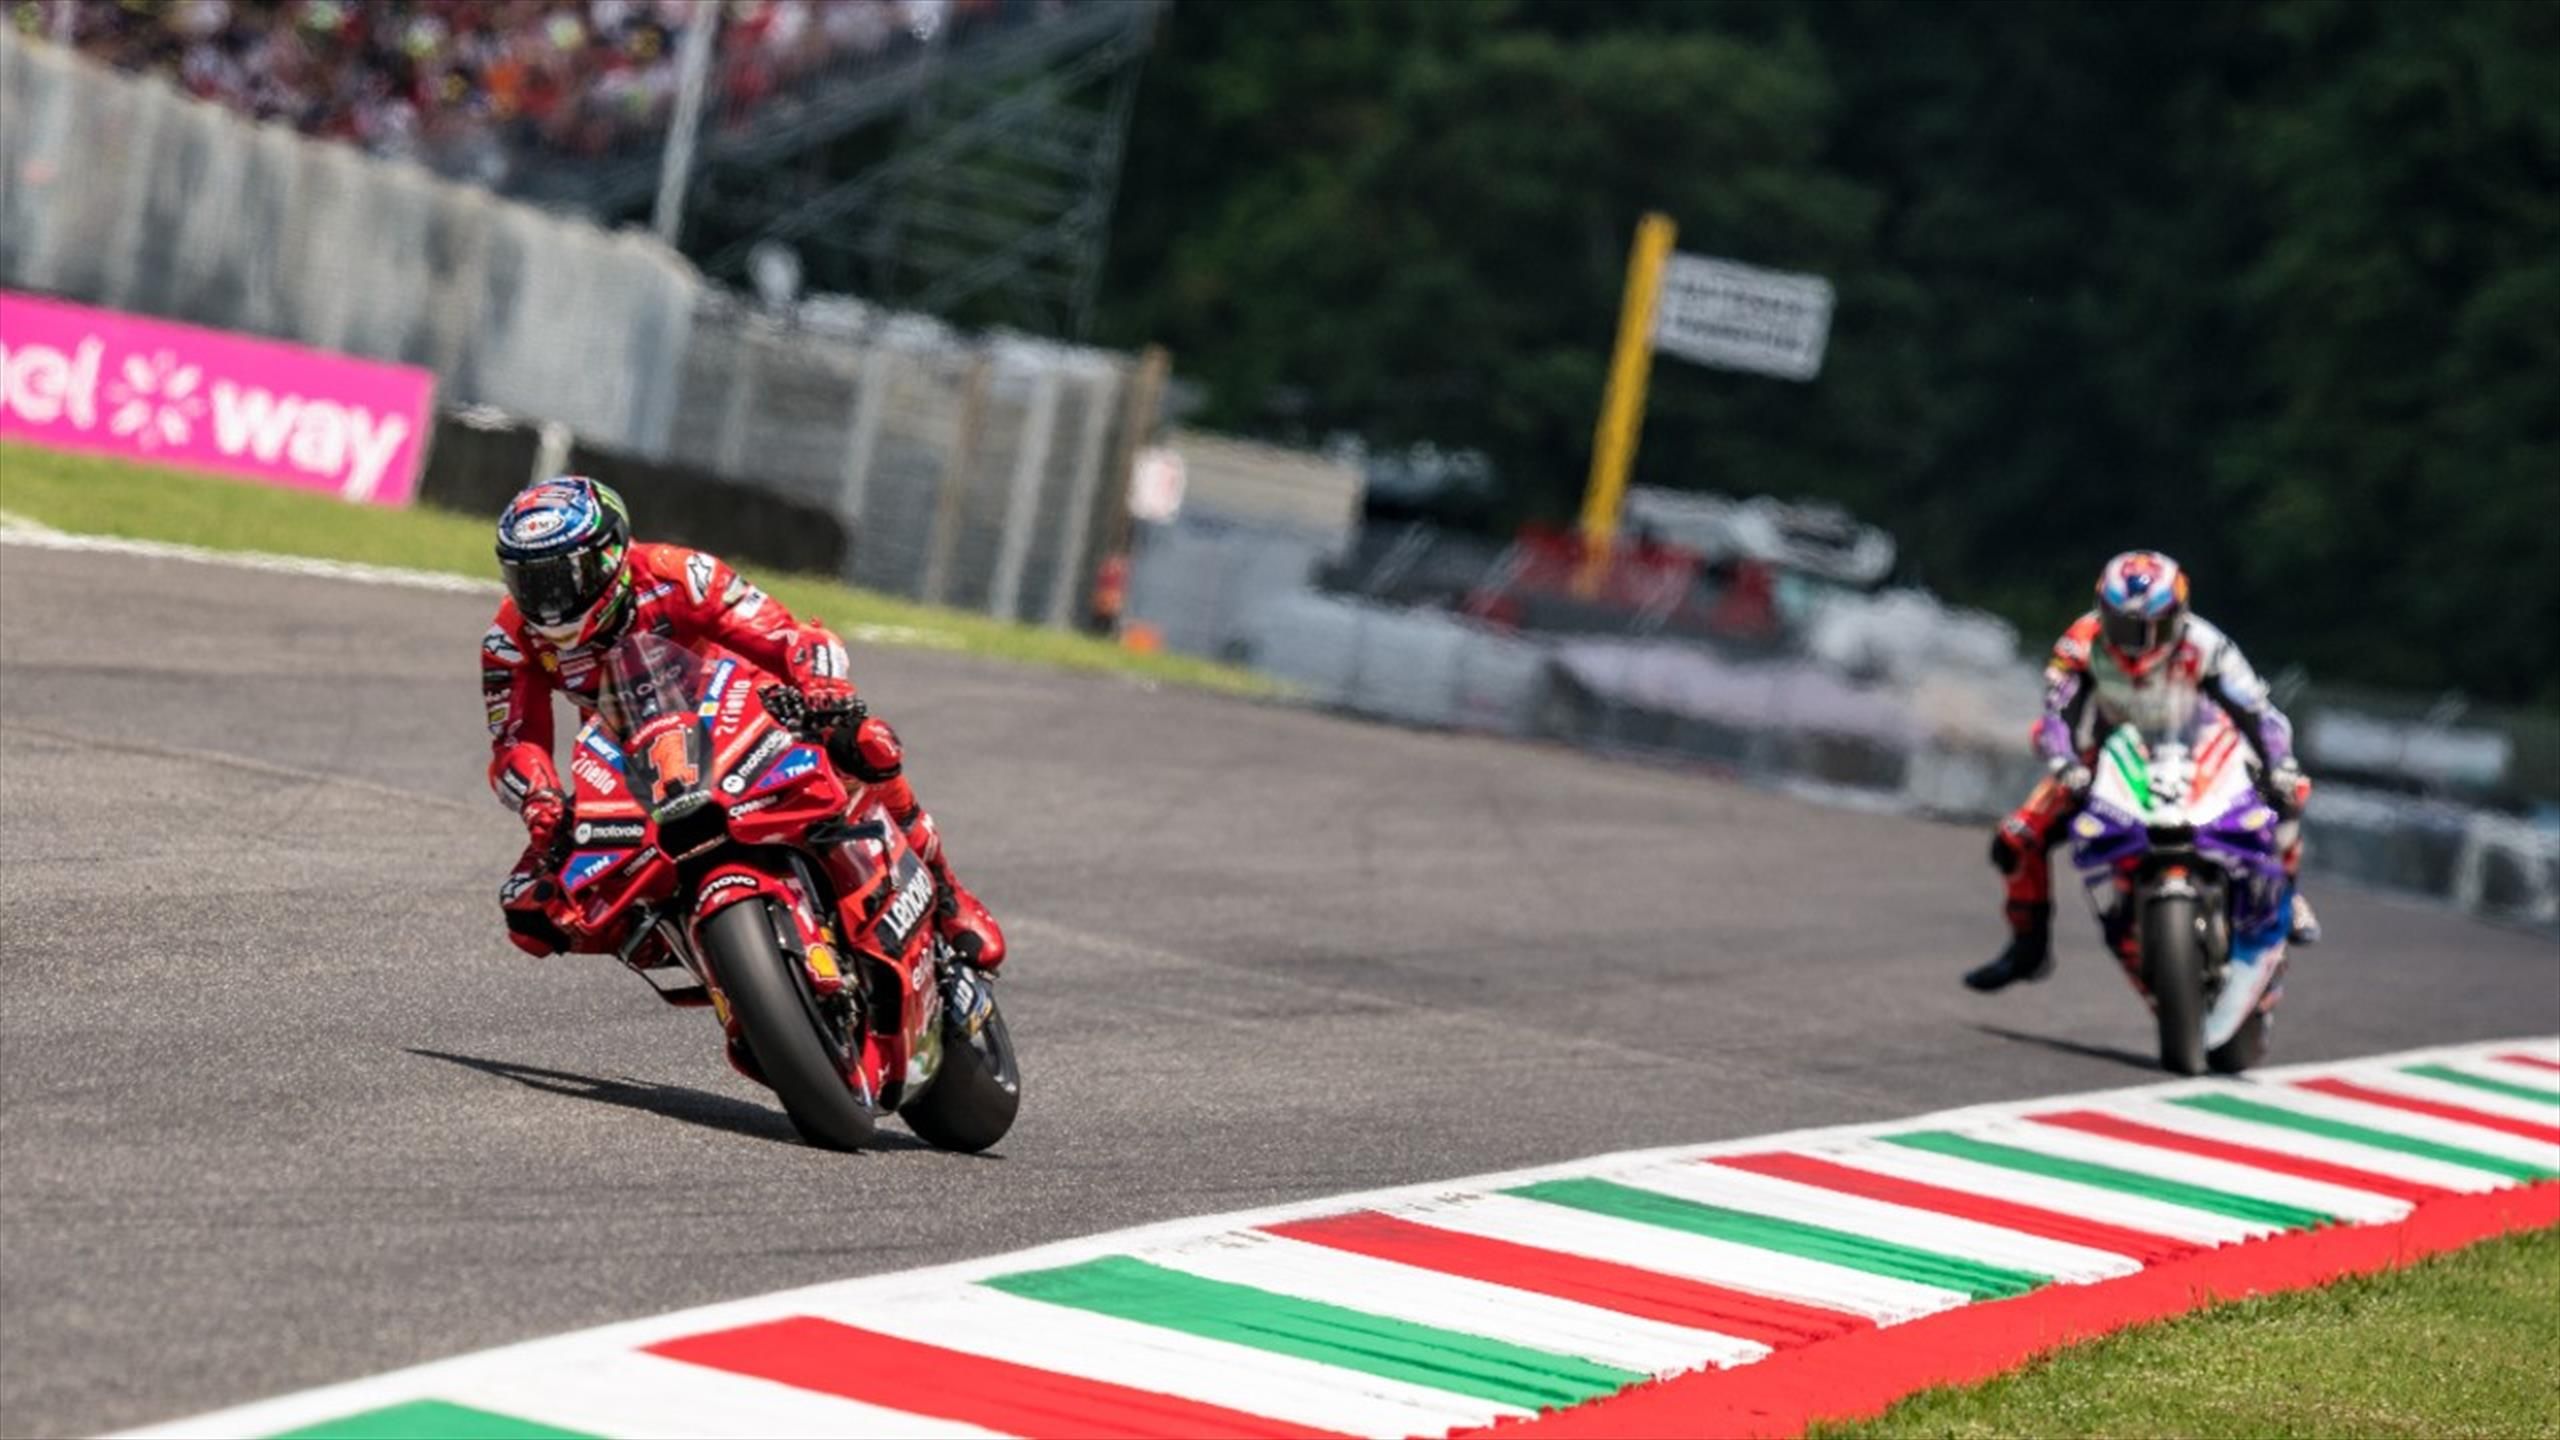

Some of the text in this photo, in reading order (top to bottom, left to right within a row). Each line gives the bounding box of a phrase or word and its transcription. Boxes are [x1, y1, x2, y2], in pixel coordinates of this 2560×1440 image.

[0, 334, 408, 502] el way
[648, 726, 699, 804] 1
[785, 762, 815, 779] TIM
[593, 824, 644, 838] motorola
[584, 855, 611, 877] TIM
